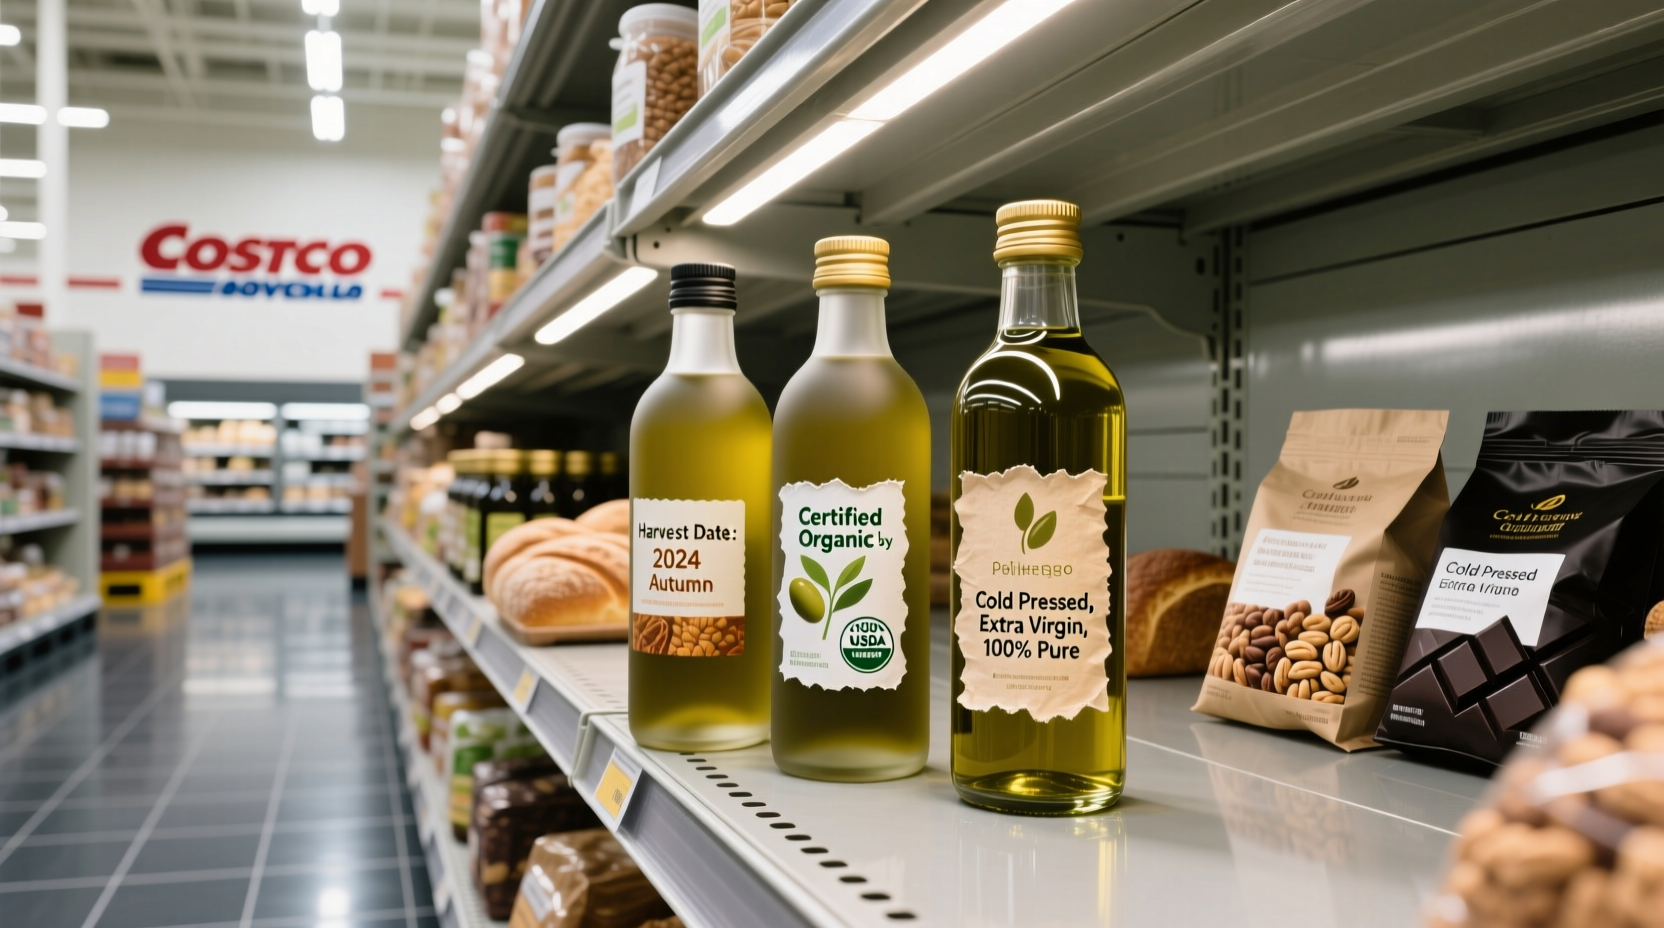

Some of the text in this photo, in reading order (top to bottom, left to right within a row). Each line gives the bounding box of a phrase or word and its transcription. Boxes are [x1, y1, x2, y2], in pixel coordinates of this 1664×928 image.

[798, 506, 882, 526] Certified
[638, 522, 737, 541] Harvest Date:
[798, 528, 893, 554] Organic by
[652, 547, 701, 570] 2024
[1445, 561, 1538, 582] Cold Pressed
[648, 573, 714, 593] Autumn
[975, 590, 1094, 614] Cold Pressed,
[979, 614, 1088, 640] Extra Virgin,
[849, 635, 887, 647] USDA
[983, 638, 1080, 660] 100% Pure
